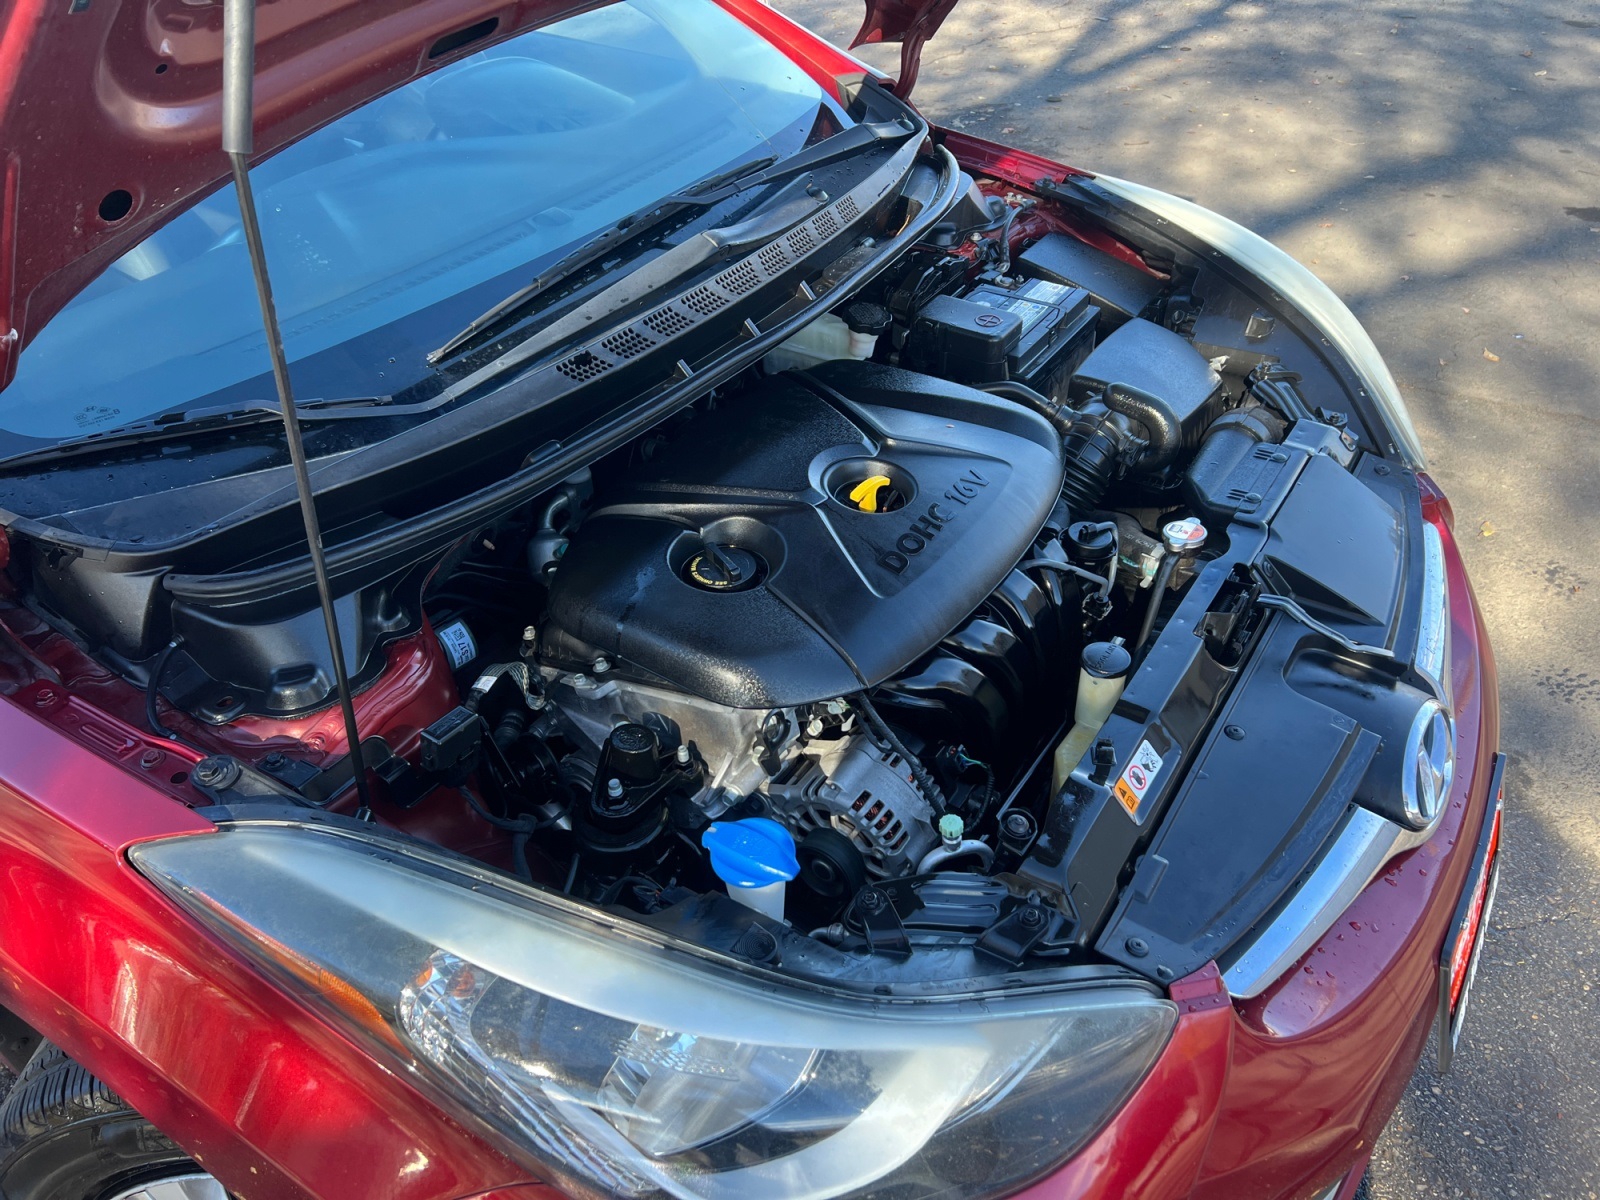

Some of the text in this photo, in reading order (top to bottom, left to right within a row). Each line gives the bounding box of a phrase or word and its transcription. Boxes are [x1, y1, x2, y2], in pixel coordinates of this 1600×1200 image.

[877, 467, 990, 575] DOHC 16V
[458, 642, 469, 656] S17
